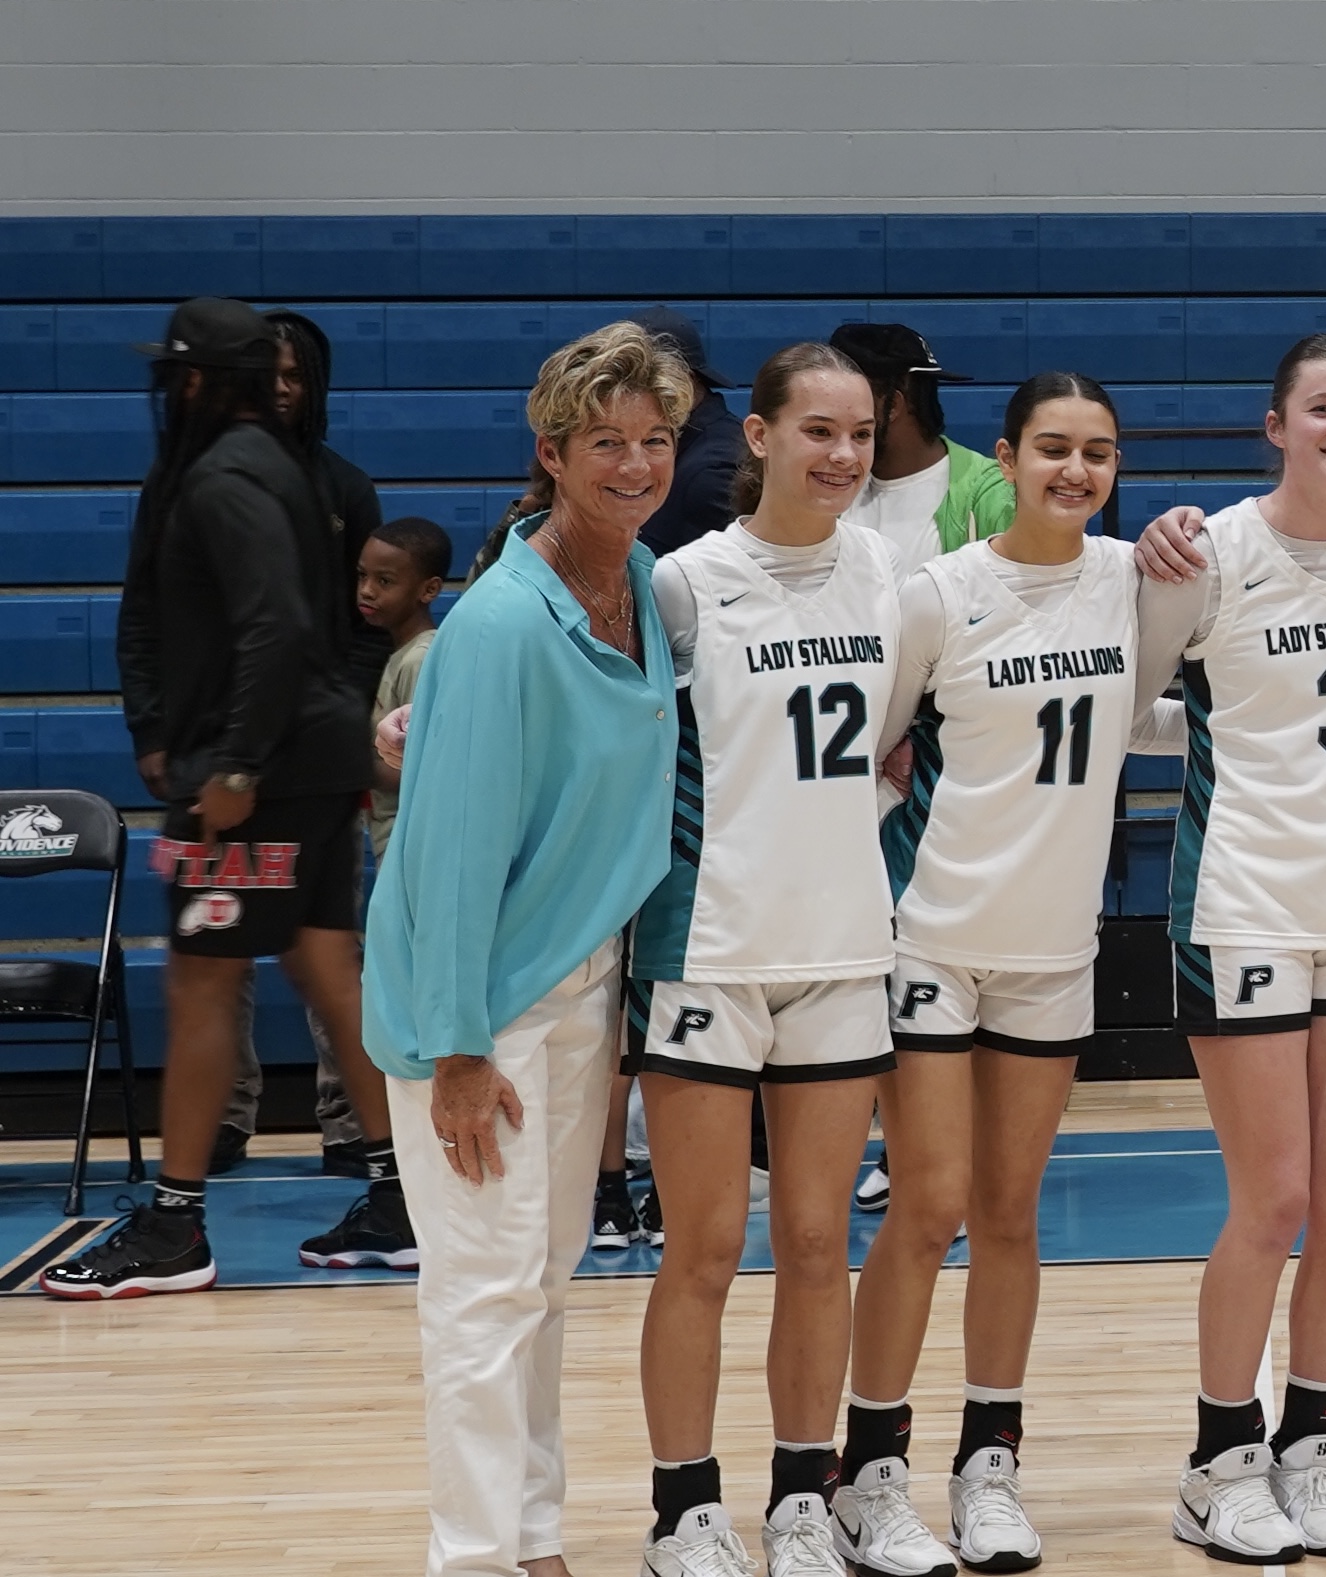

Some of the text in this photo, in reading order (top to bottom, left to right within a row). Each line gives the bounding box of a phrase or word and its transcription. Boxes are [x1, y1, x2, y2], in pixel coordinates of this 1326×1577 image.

[746, 635, 884, 673] LADY STALLIONS
[1265, 624, 1311, 656] LADY
[987, 646, 1125, 688] LADY STALLIONS
[787, 681, 869, 781] 12
[1034, 694, 1094, 785] 11
